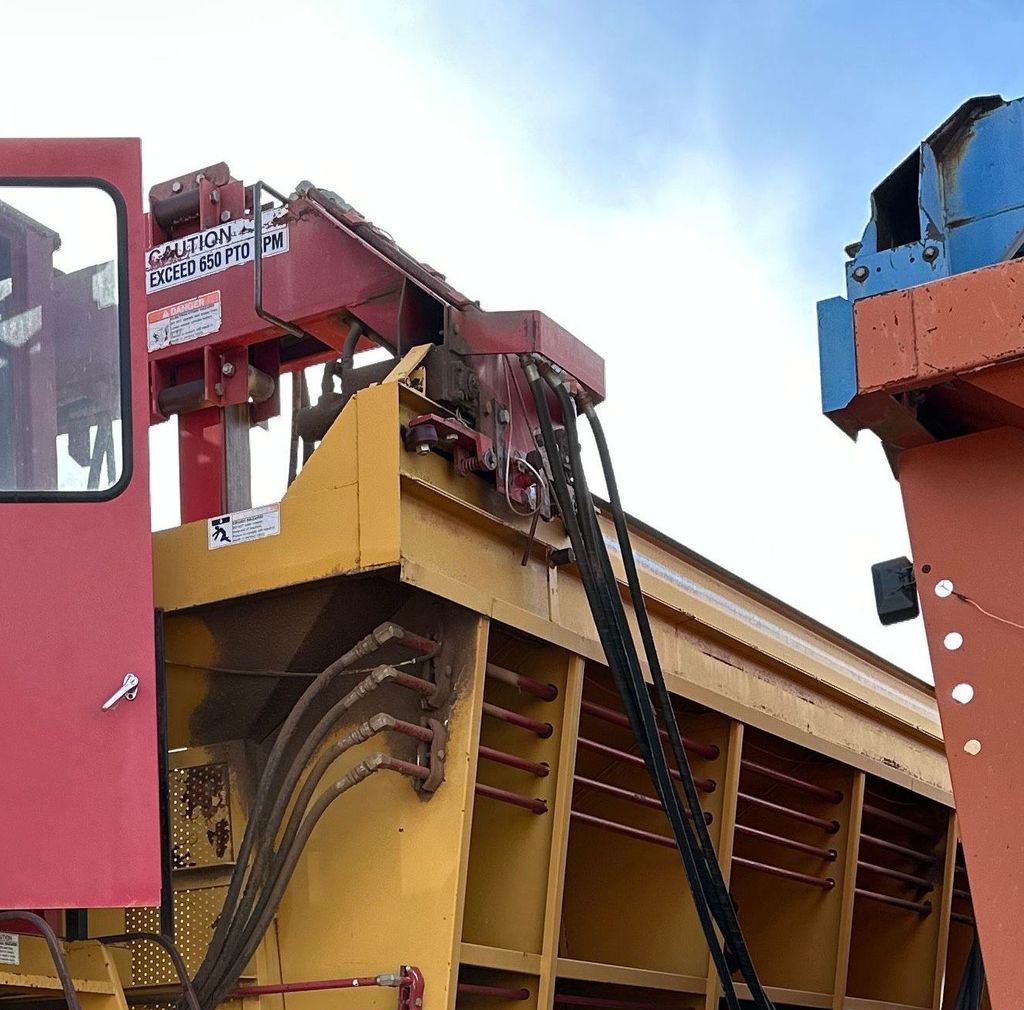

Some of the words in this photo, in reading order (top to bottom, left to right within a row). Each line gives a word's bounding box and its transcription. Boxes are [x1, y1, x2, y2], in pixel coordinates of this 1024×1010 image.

[148, 225, 233, 267] CAUTION
[150, 259, 196, 288] EXCEED
[199, 251, 222, 273] 650
[225, 242, 250, 265] PTO
[262, 231, 283, 253] PM
[170, 299, 206, 316] DANGER
